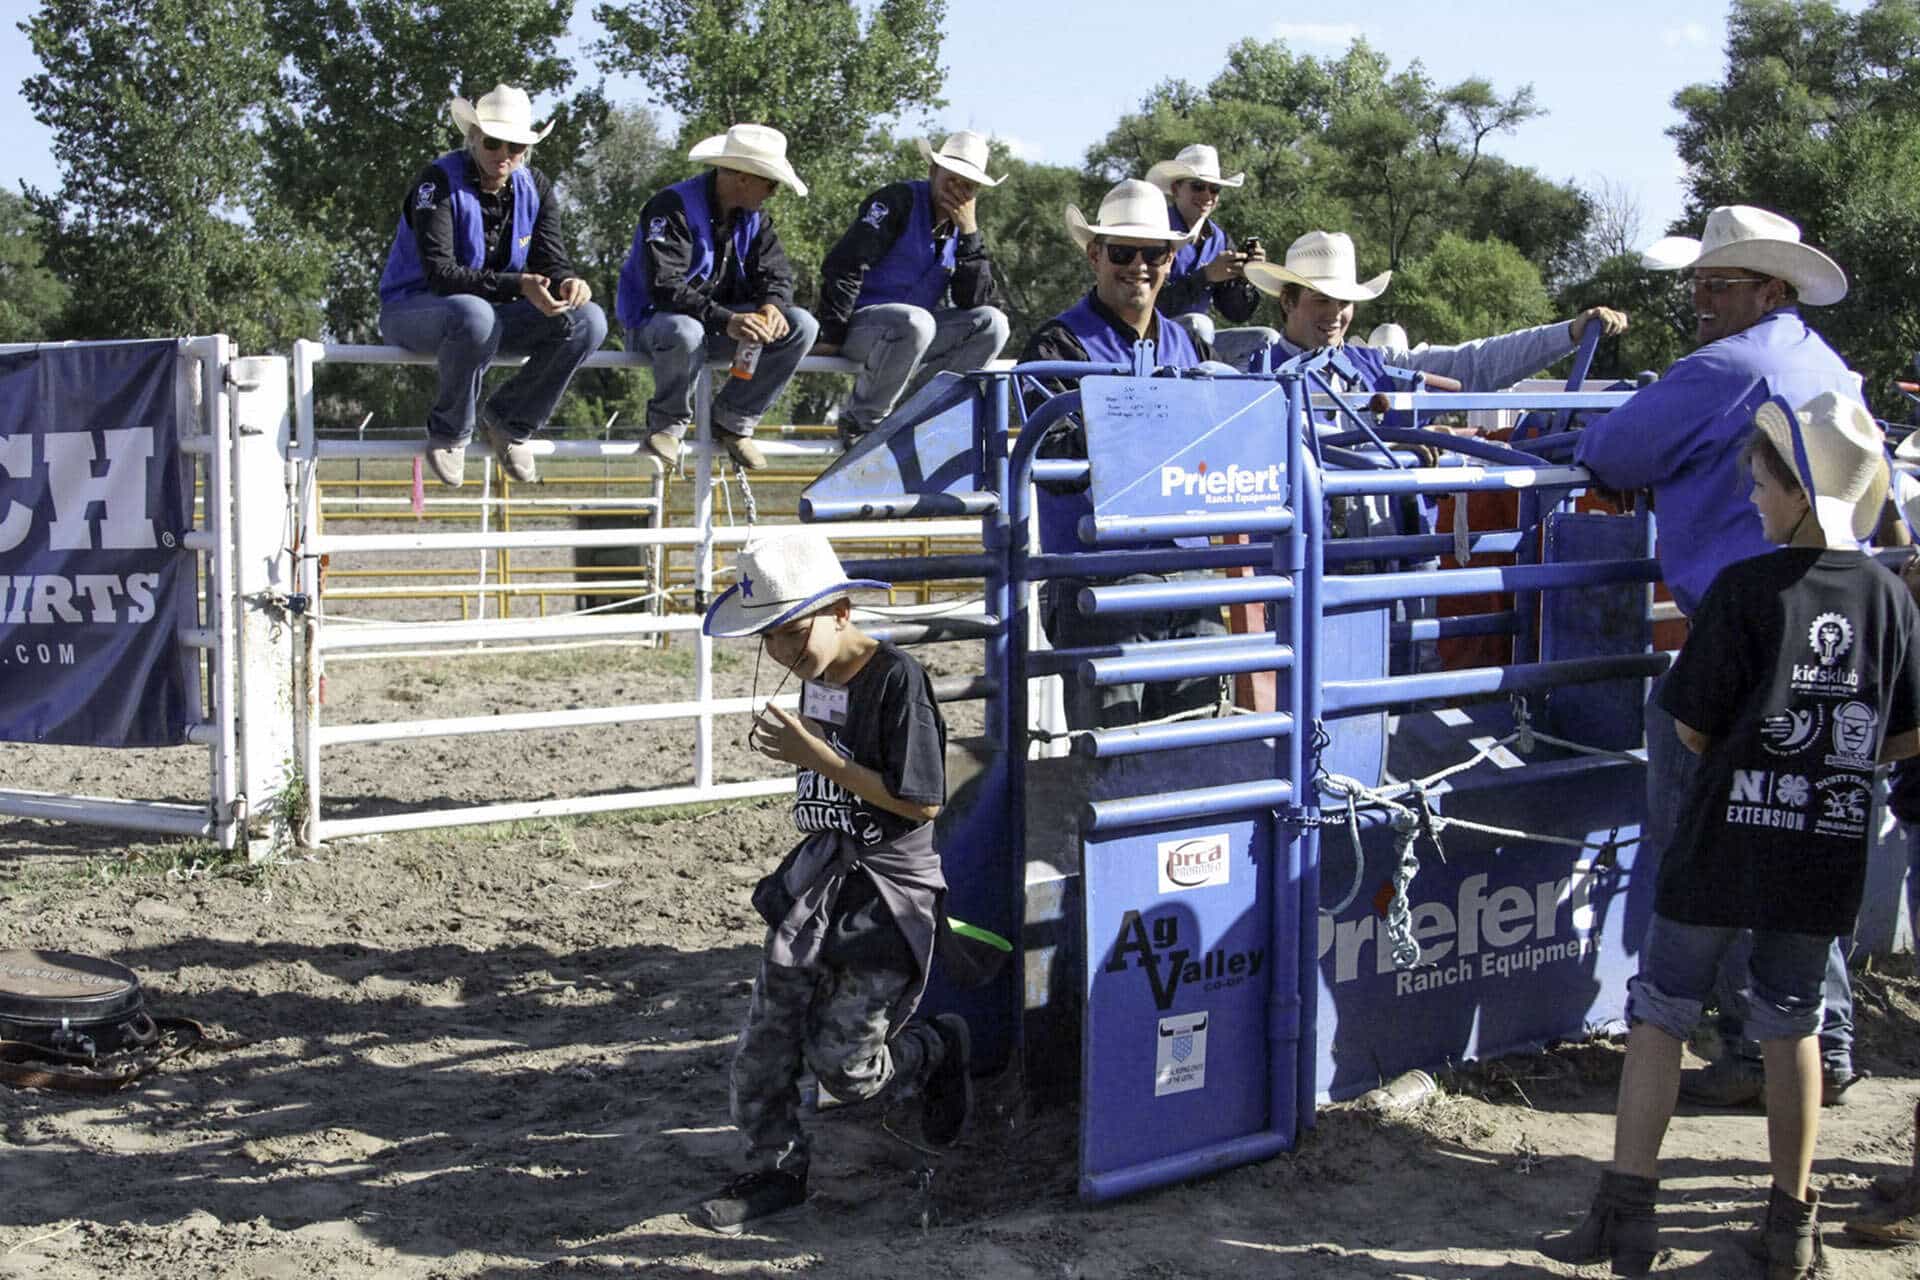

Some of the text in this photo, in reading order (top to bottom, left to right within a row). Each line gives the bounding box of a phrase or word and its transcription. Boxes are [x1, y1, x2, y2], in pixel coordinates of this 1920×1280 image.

[1161, 461, 1279, 496] Priefert
[1205, 492, 1281, 504] Ranch Equipment
[1727, 805, 1806, 832] EXTENSION
[1168, 844, 1221, 880] prca
[1106, 910, 1178, 974] Ag
[1144, 948, 1264, 1011] Valley
[1396, 934, 1601, 996] Ranch Equipment
